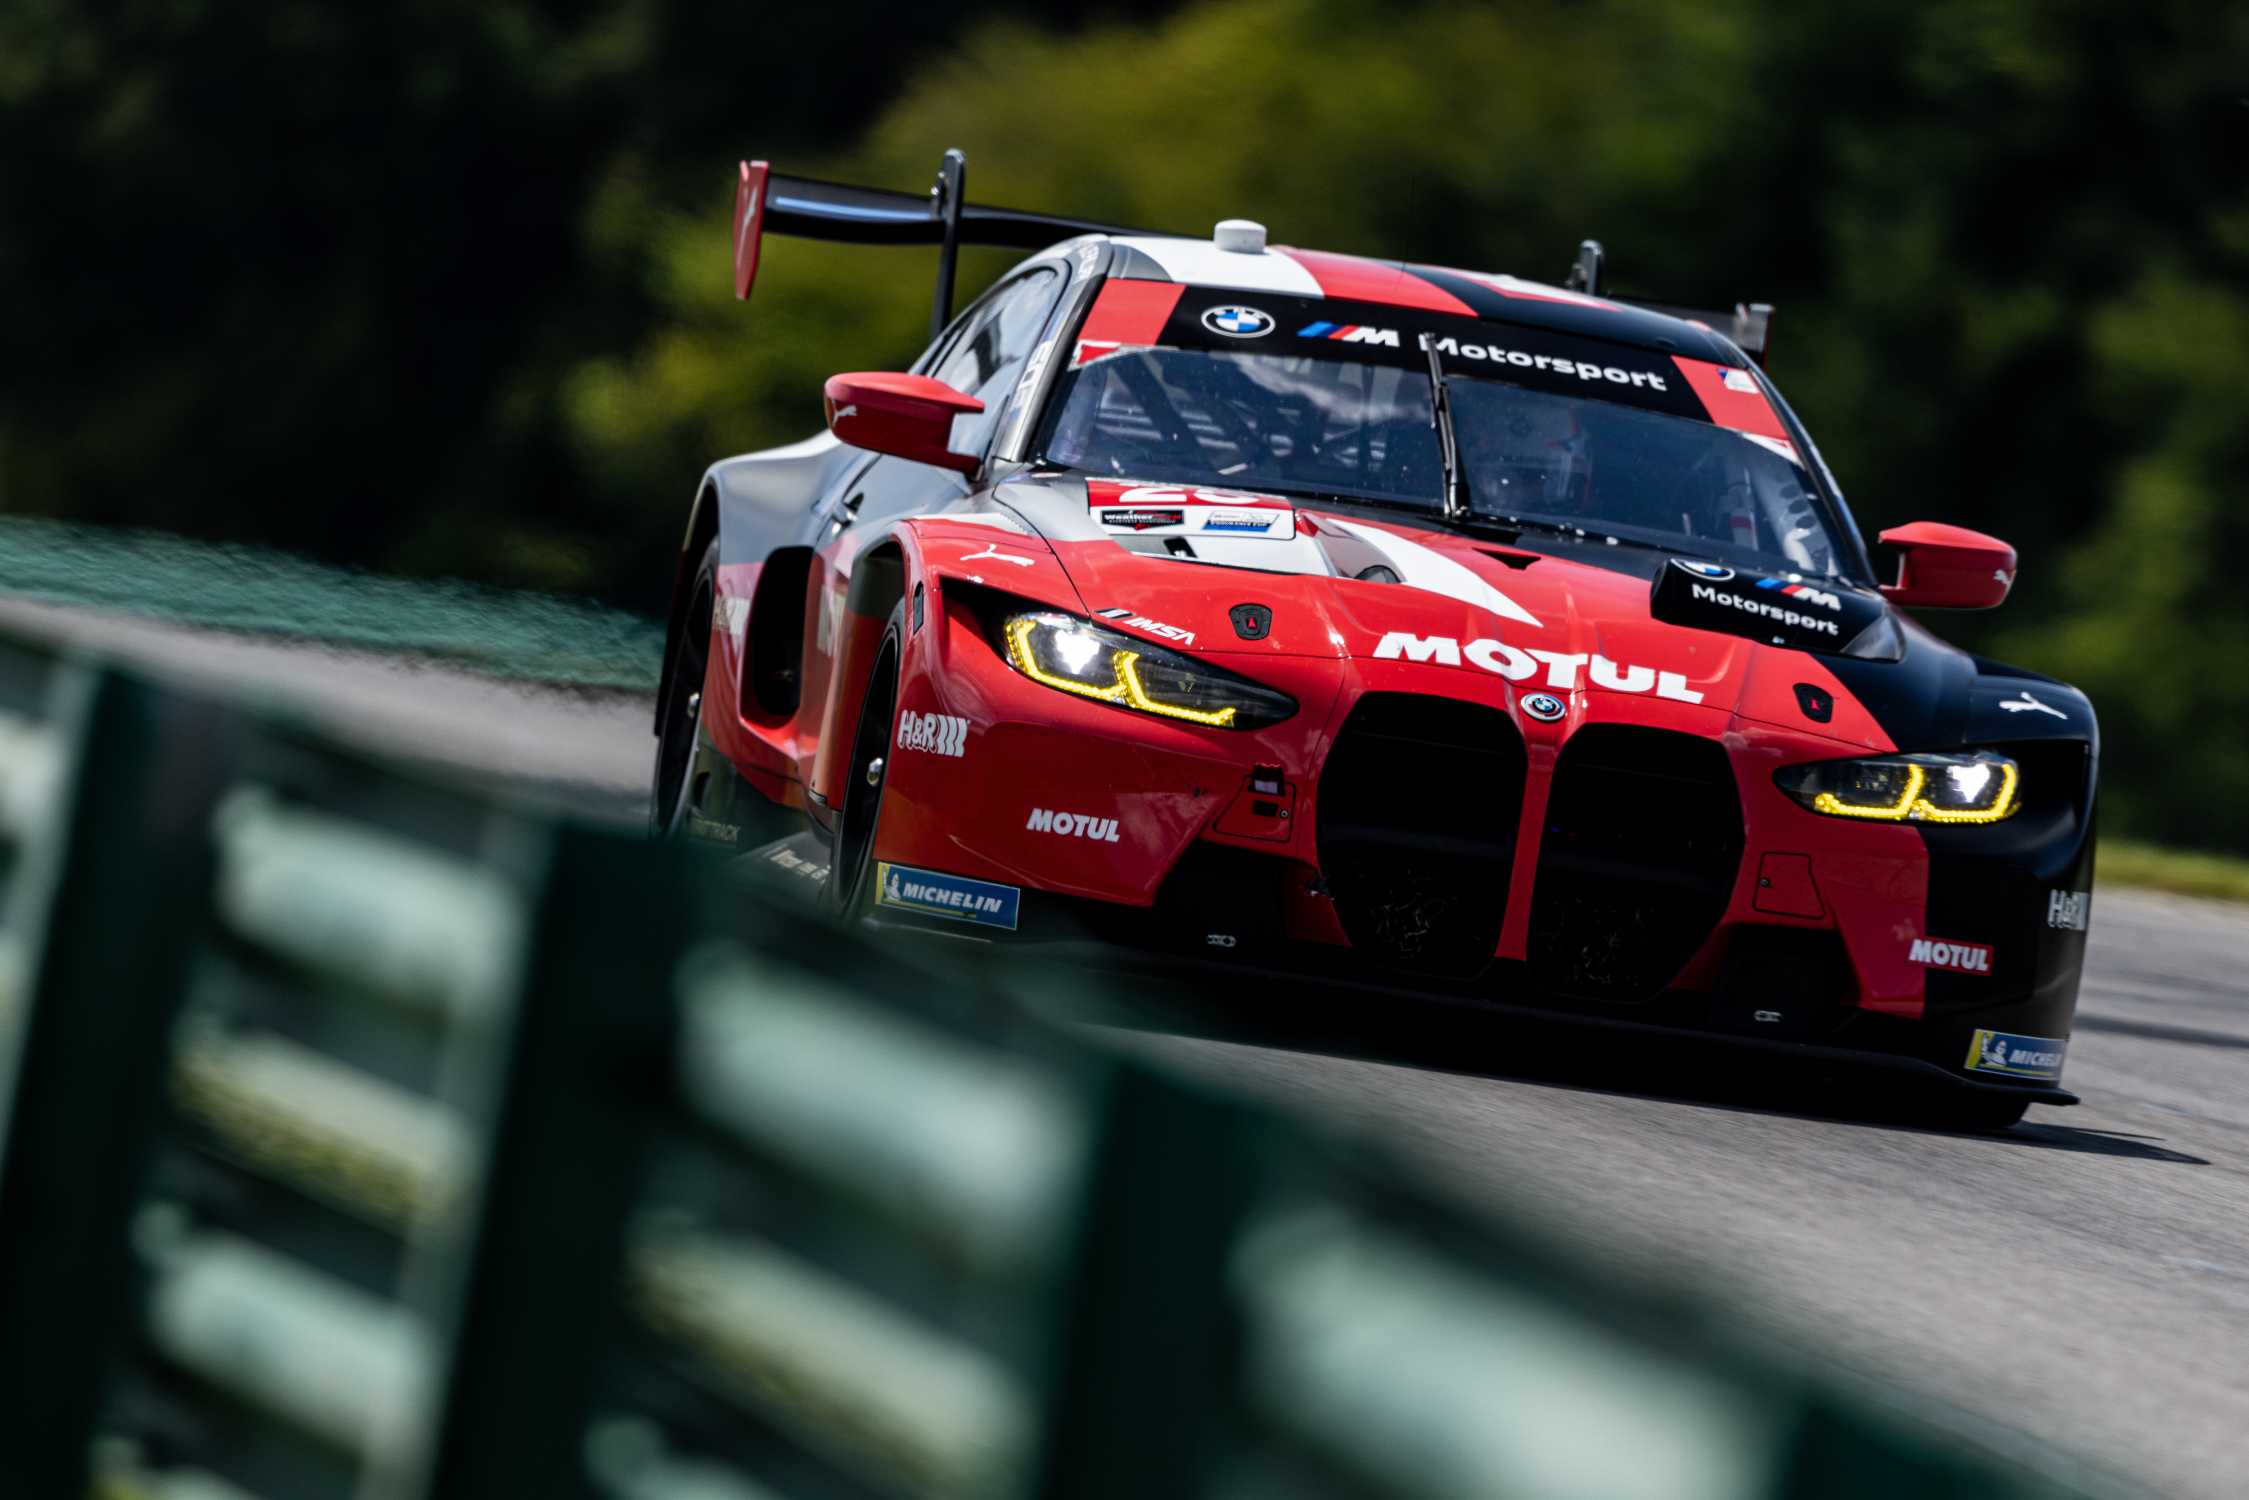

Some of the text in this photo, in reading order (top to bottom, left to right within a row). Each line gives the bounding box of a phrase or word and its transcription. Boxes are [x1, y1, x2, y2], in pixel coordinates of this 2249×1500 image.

[1418, 332, 1668, 391] Motorsport
[1692, 583, 1839, 636] Motorsport
[1122, 616, 1197, 646] IMSA
[1372, 631, 1704, 705] MOTUL
[1026, 808, 1121, 843] MOTUL
[903, 882, 1003, 913] MICHELIN
[1909, 939, 1989, 971] MOTUL
